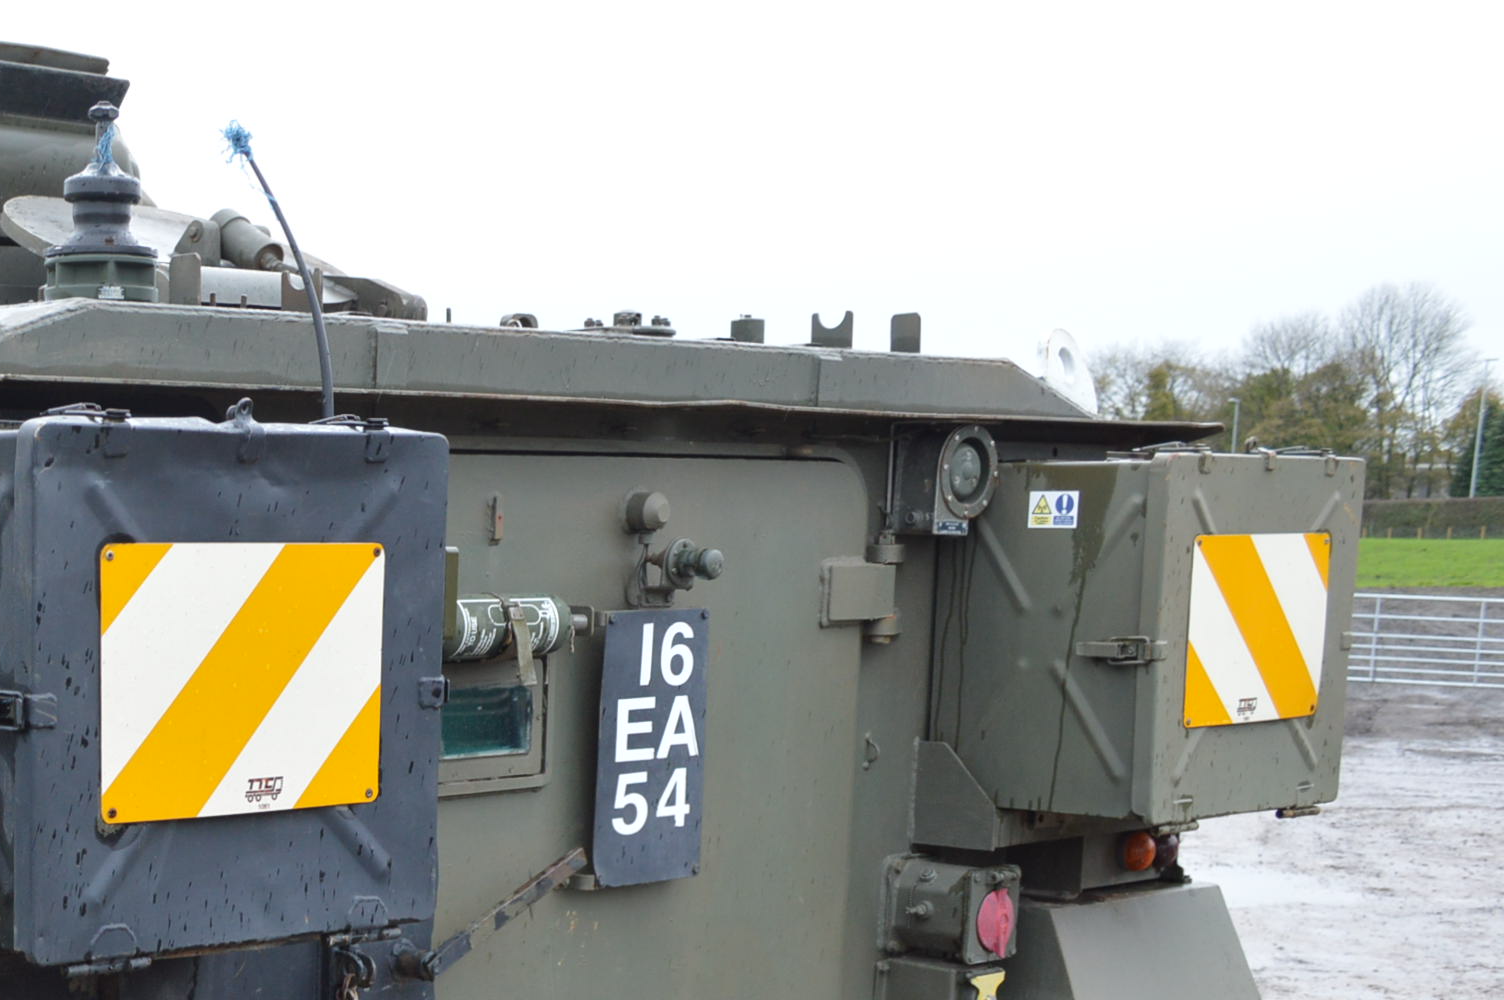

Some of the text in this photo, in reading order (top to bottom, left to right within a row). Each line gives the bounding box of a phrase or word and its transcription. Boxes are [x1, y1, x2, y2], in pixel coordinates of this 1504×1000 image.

[640, 621, 694, 687] 16
[615, 695, 699, 763] EA
[611, 767, 690, 835] 54
